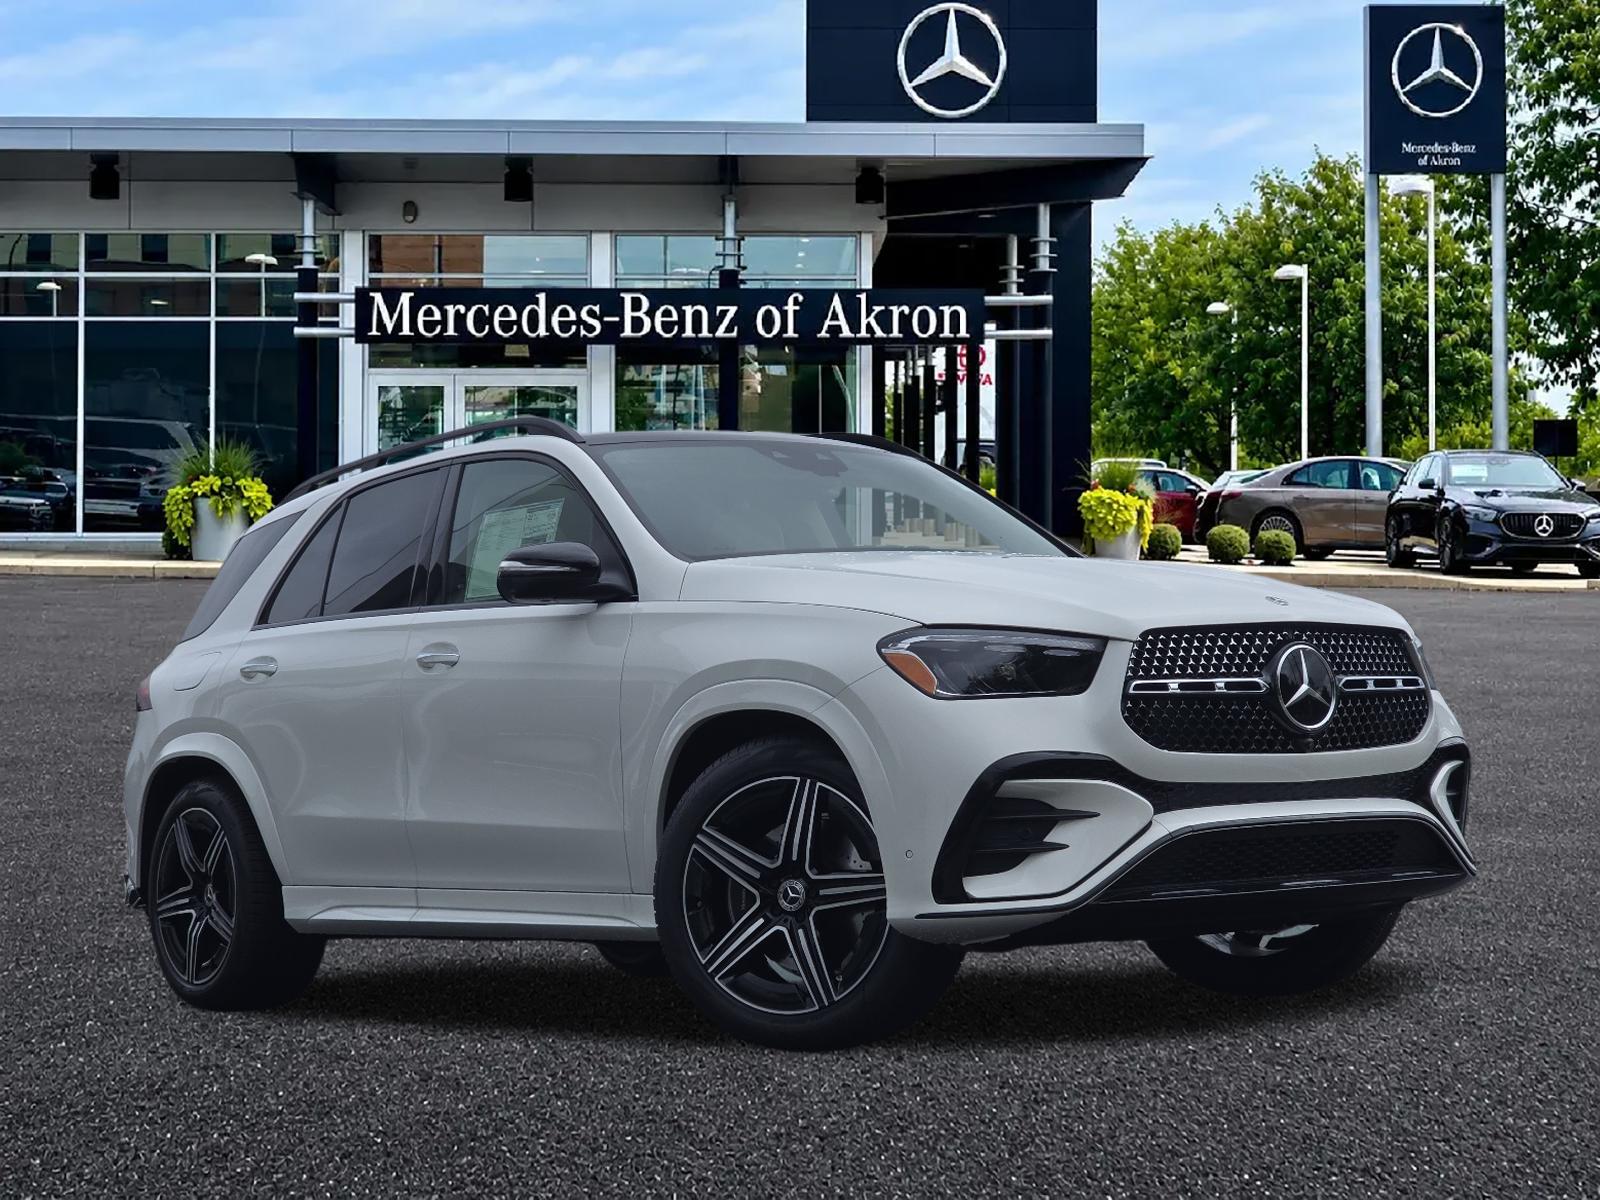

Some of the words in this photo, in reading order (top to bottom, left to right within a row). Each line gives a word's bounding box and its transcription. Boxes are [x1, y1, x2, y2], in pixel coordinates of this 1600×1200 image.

[1401, 141, 1477, 153] Mercedes-Benz
[1417, 154, 1429, 166] of
[1430, 154, 1461, 166] Akron
[367, 292, 738, 338] Mercedes-Benz
[755, 292, 804, 338] of
[816, 292, 970, 338] Akron
